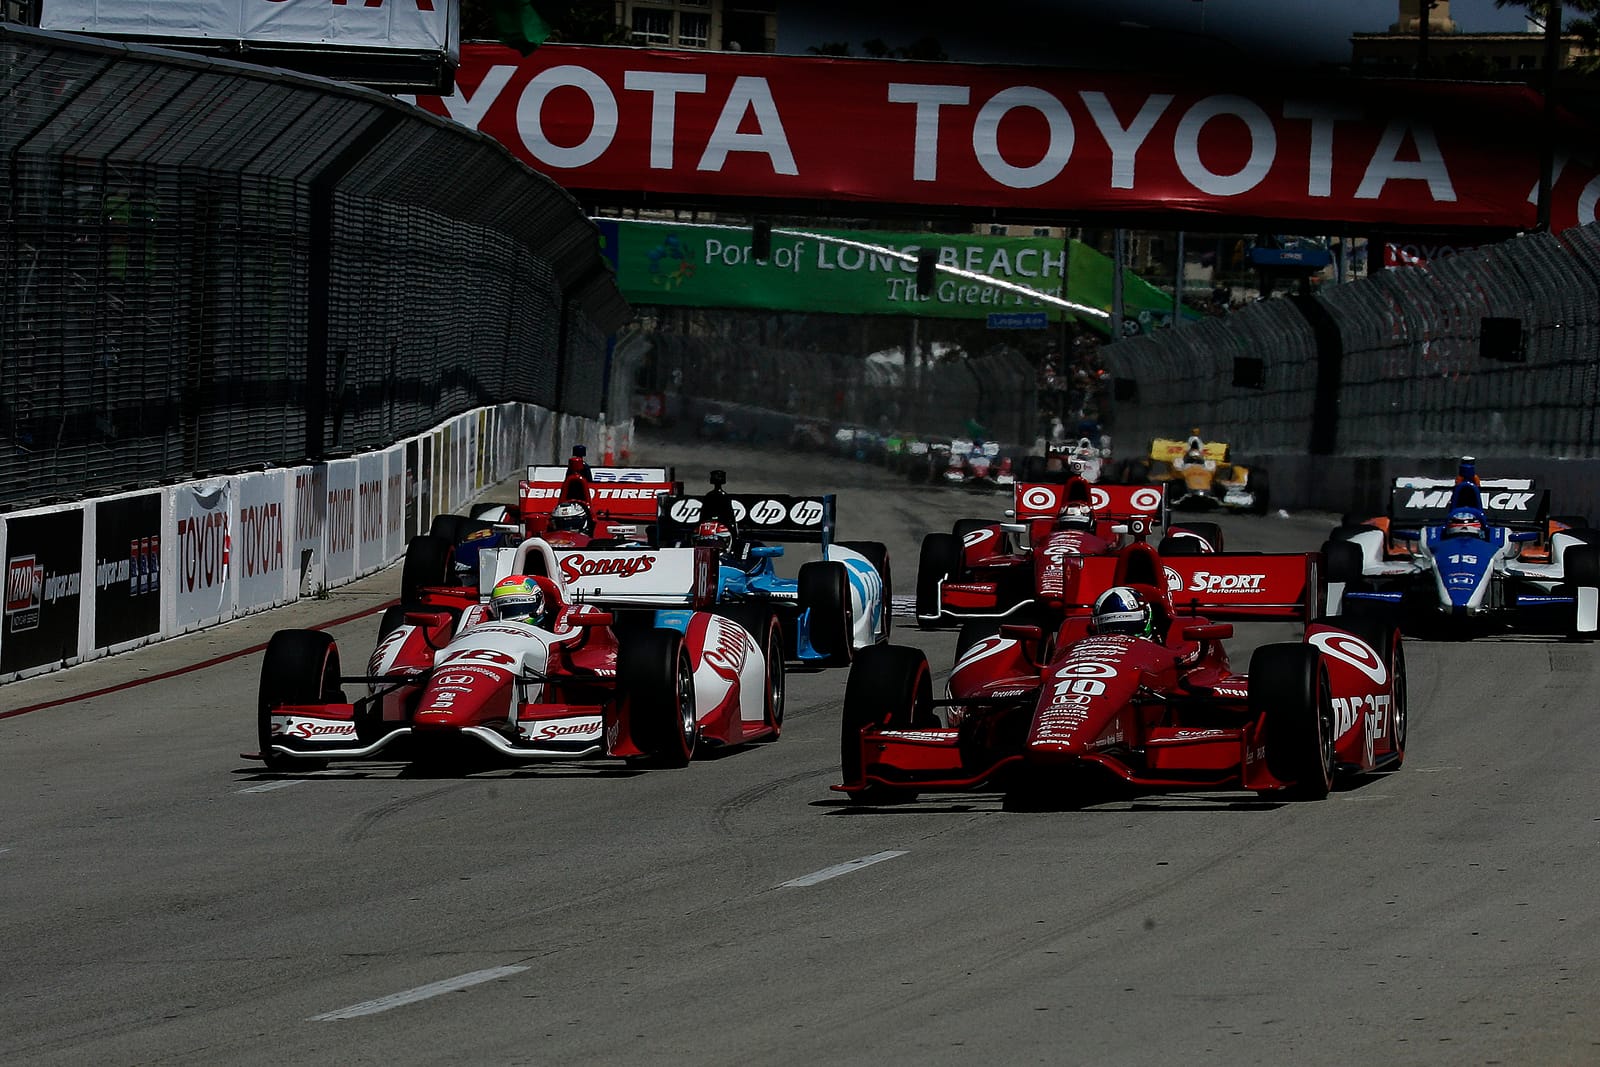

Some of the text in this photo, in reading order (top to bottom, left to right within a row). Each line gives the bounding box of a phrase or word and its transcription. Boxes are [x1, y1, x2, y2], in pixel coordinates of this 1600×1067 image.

[437, 64, 799, 176] YOTA
[888, 81, 1458, 203] TOYOTA
[704, 239, 768, 267] Por
[774, 241, 805, 273] of
[938, 246, 1066, 279] BEACH
[886, 277, 931, 303] Th
[597, 487, 671, 500] TIRES
[328, 488, 354, 554] TOYOTA
[753, 499, 785, 525] hp
[795, 499, 822, 526] hp
[240, 502, 284, 578] TOYOTA
[9, 565, 32, 602] IZOD
[559, 553, 656, 585] Sonny's
[1187, 571, 1266, 592] SPORT
[1053, 679, 1106, 696] 10
